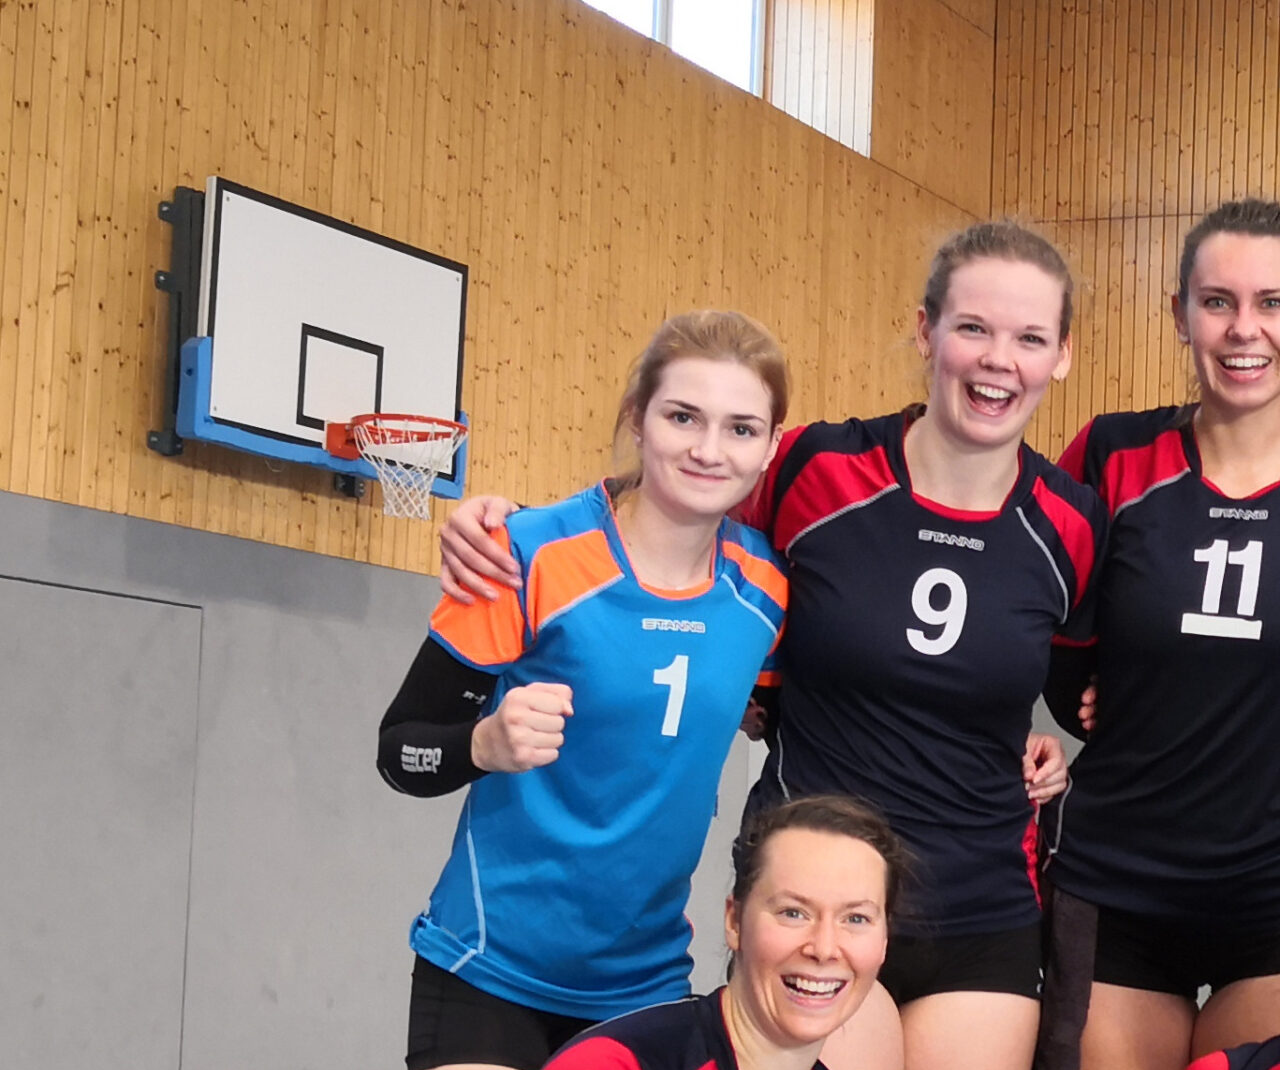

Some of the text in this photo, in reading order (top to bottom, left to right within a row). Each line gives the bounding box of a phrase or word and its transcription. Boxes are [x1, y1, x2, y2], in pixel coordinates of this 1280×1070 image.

[1209, 507, 1269, 520] STANNO
[918, 529, 985, 551] STANNO
[1194, 540, 1263, 617] 11
[642, 618, 706, 633] STANNO
[907, 568, 967, 655] 9
[652, 655, 689, 737] 1
